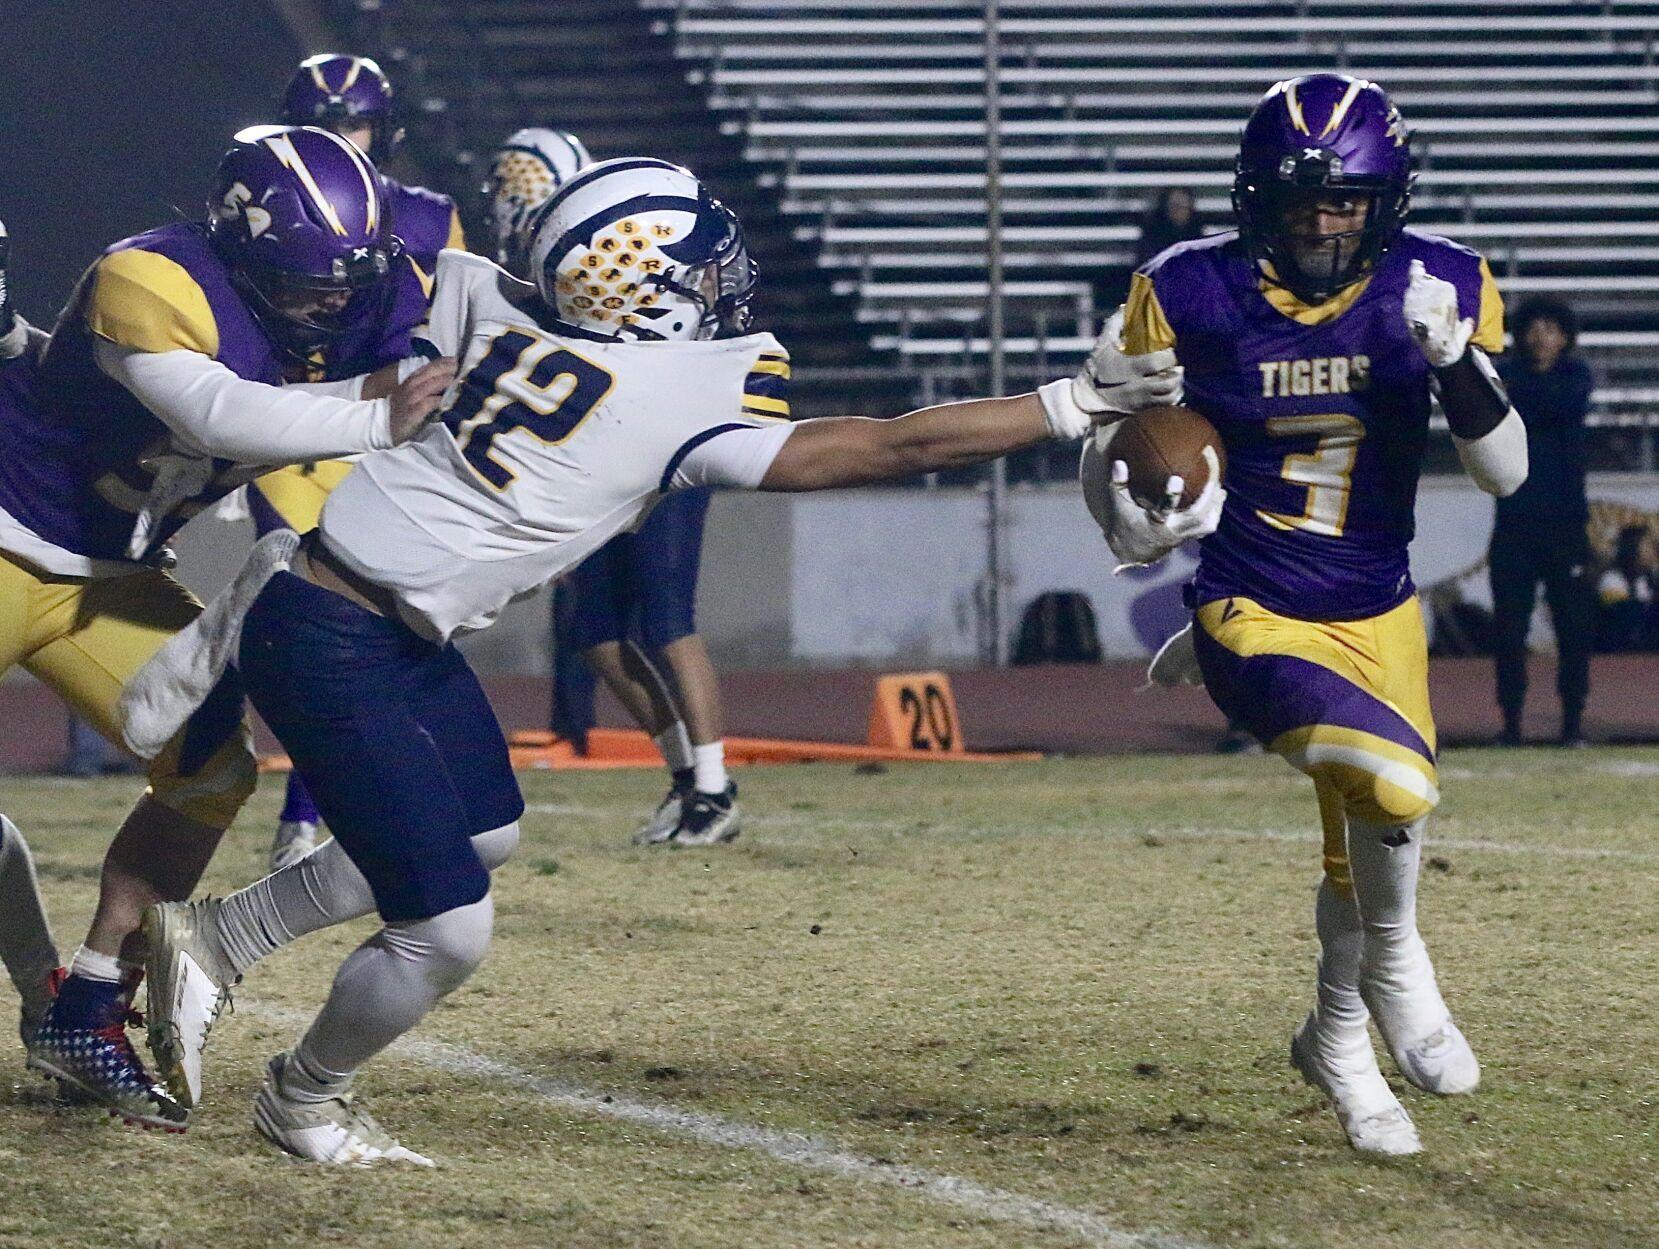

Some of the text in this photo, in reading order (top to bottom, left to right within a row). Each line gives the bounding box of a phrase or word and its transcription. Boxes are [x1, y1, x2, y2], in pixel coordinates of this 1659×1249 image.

[440, 325, 618, 493] 12
[1255, 414, 1367, 537] 3
[900, 684, 952, 751] 20
